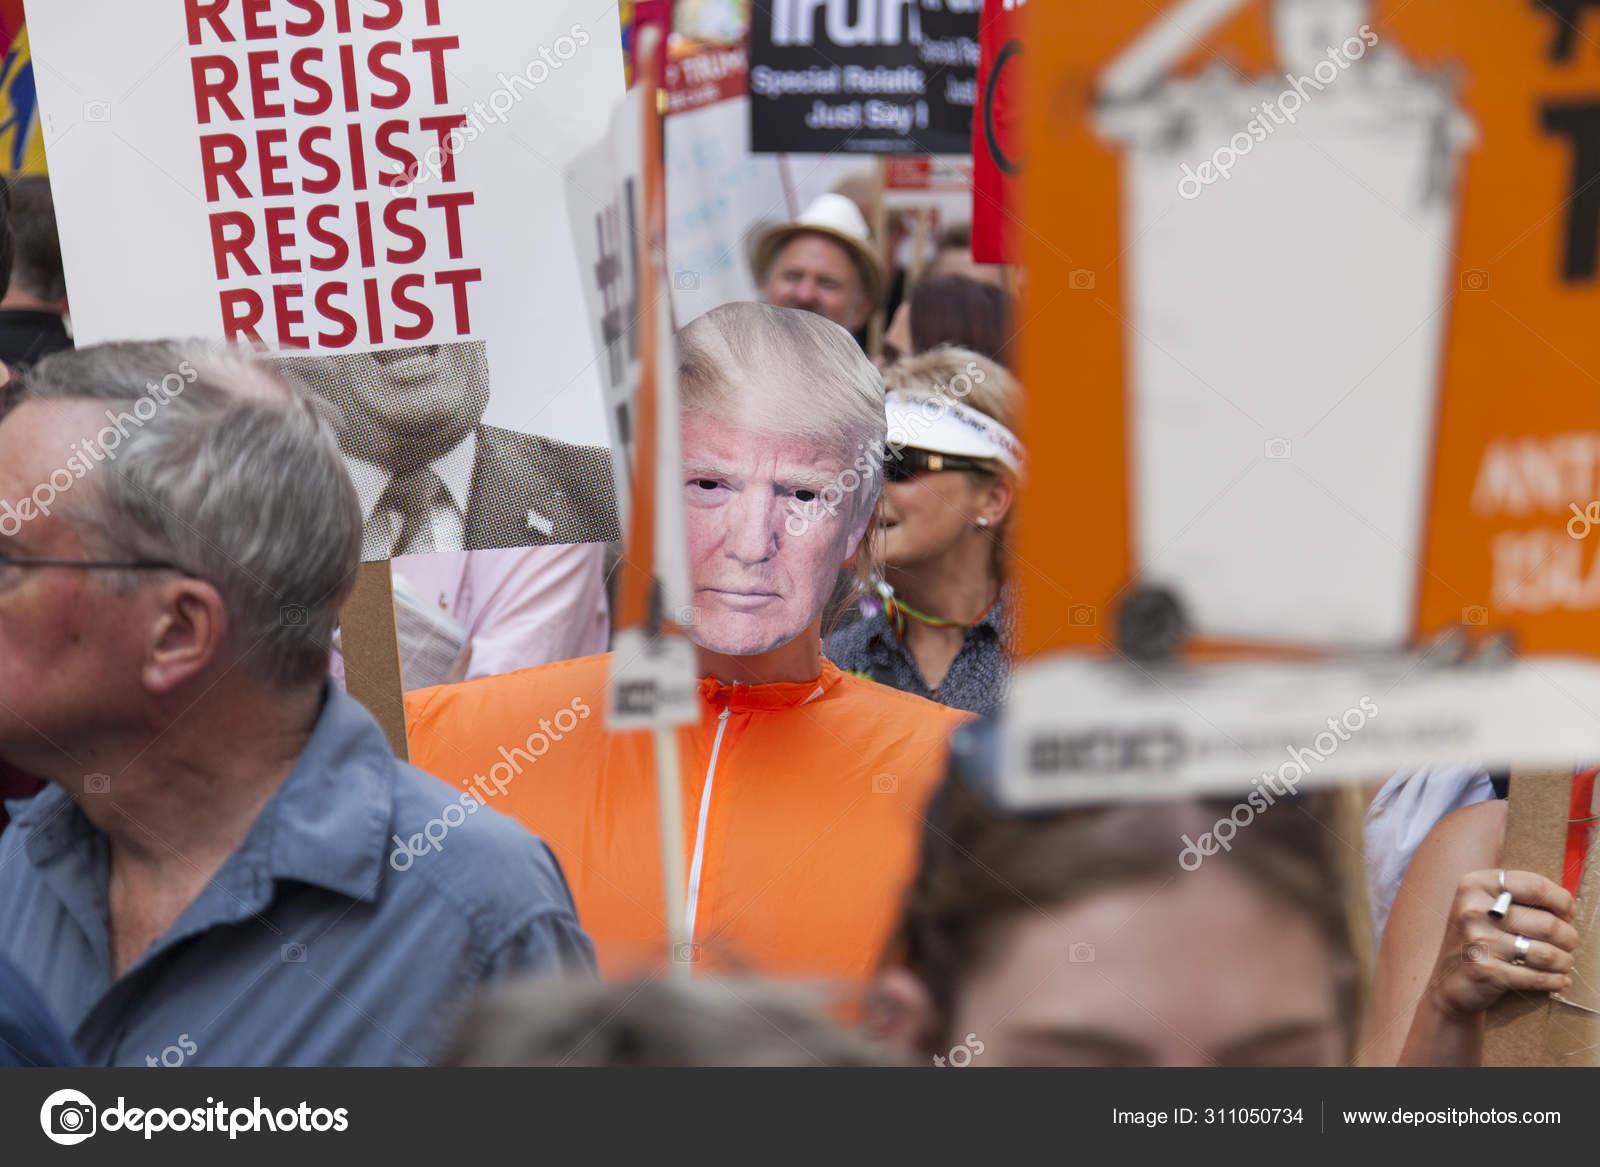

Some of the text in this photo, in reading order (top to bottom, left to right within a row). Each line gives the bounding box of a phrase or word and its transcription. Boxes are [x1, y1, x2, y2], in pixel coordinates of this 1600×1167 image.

[191, 36, 460, 124] RESIST
[751, 65, 840, 98] Special
[806, 100, 862, 129] Just
[863, 100, 915, 135] Say
[200, 114, 468, 202] RESIST
[209, 192, 474, 280] RESIST
[219, 268, 482, 352] RESIST
[1470, 434, 1600, 517] ANT
